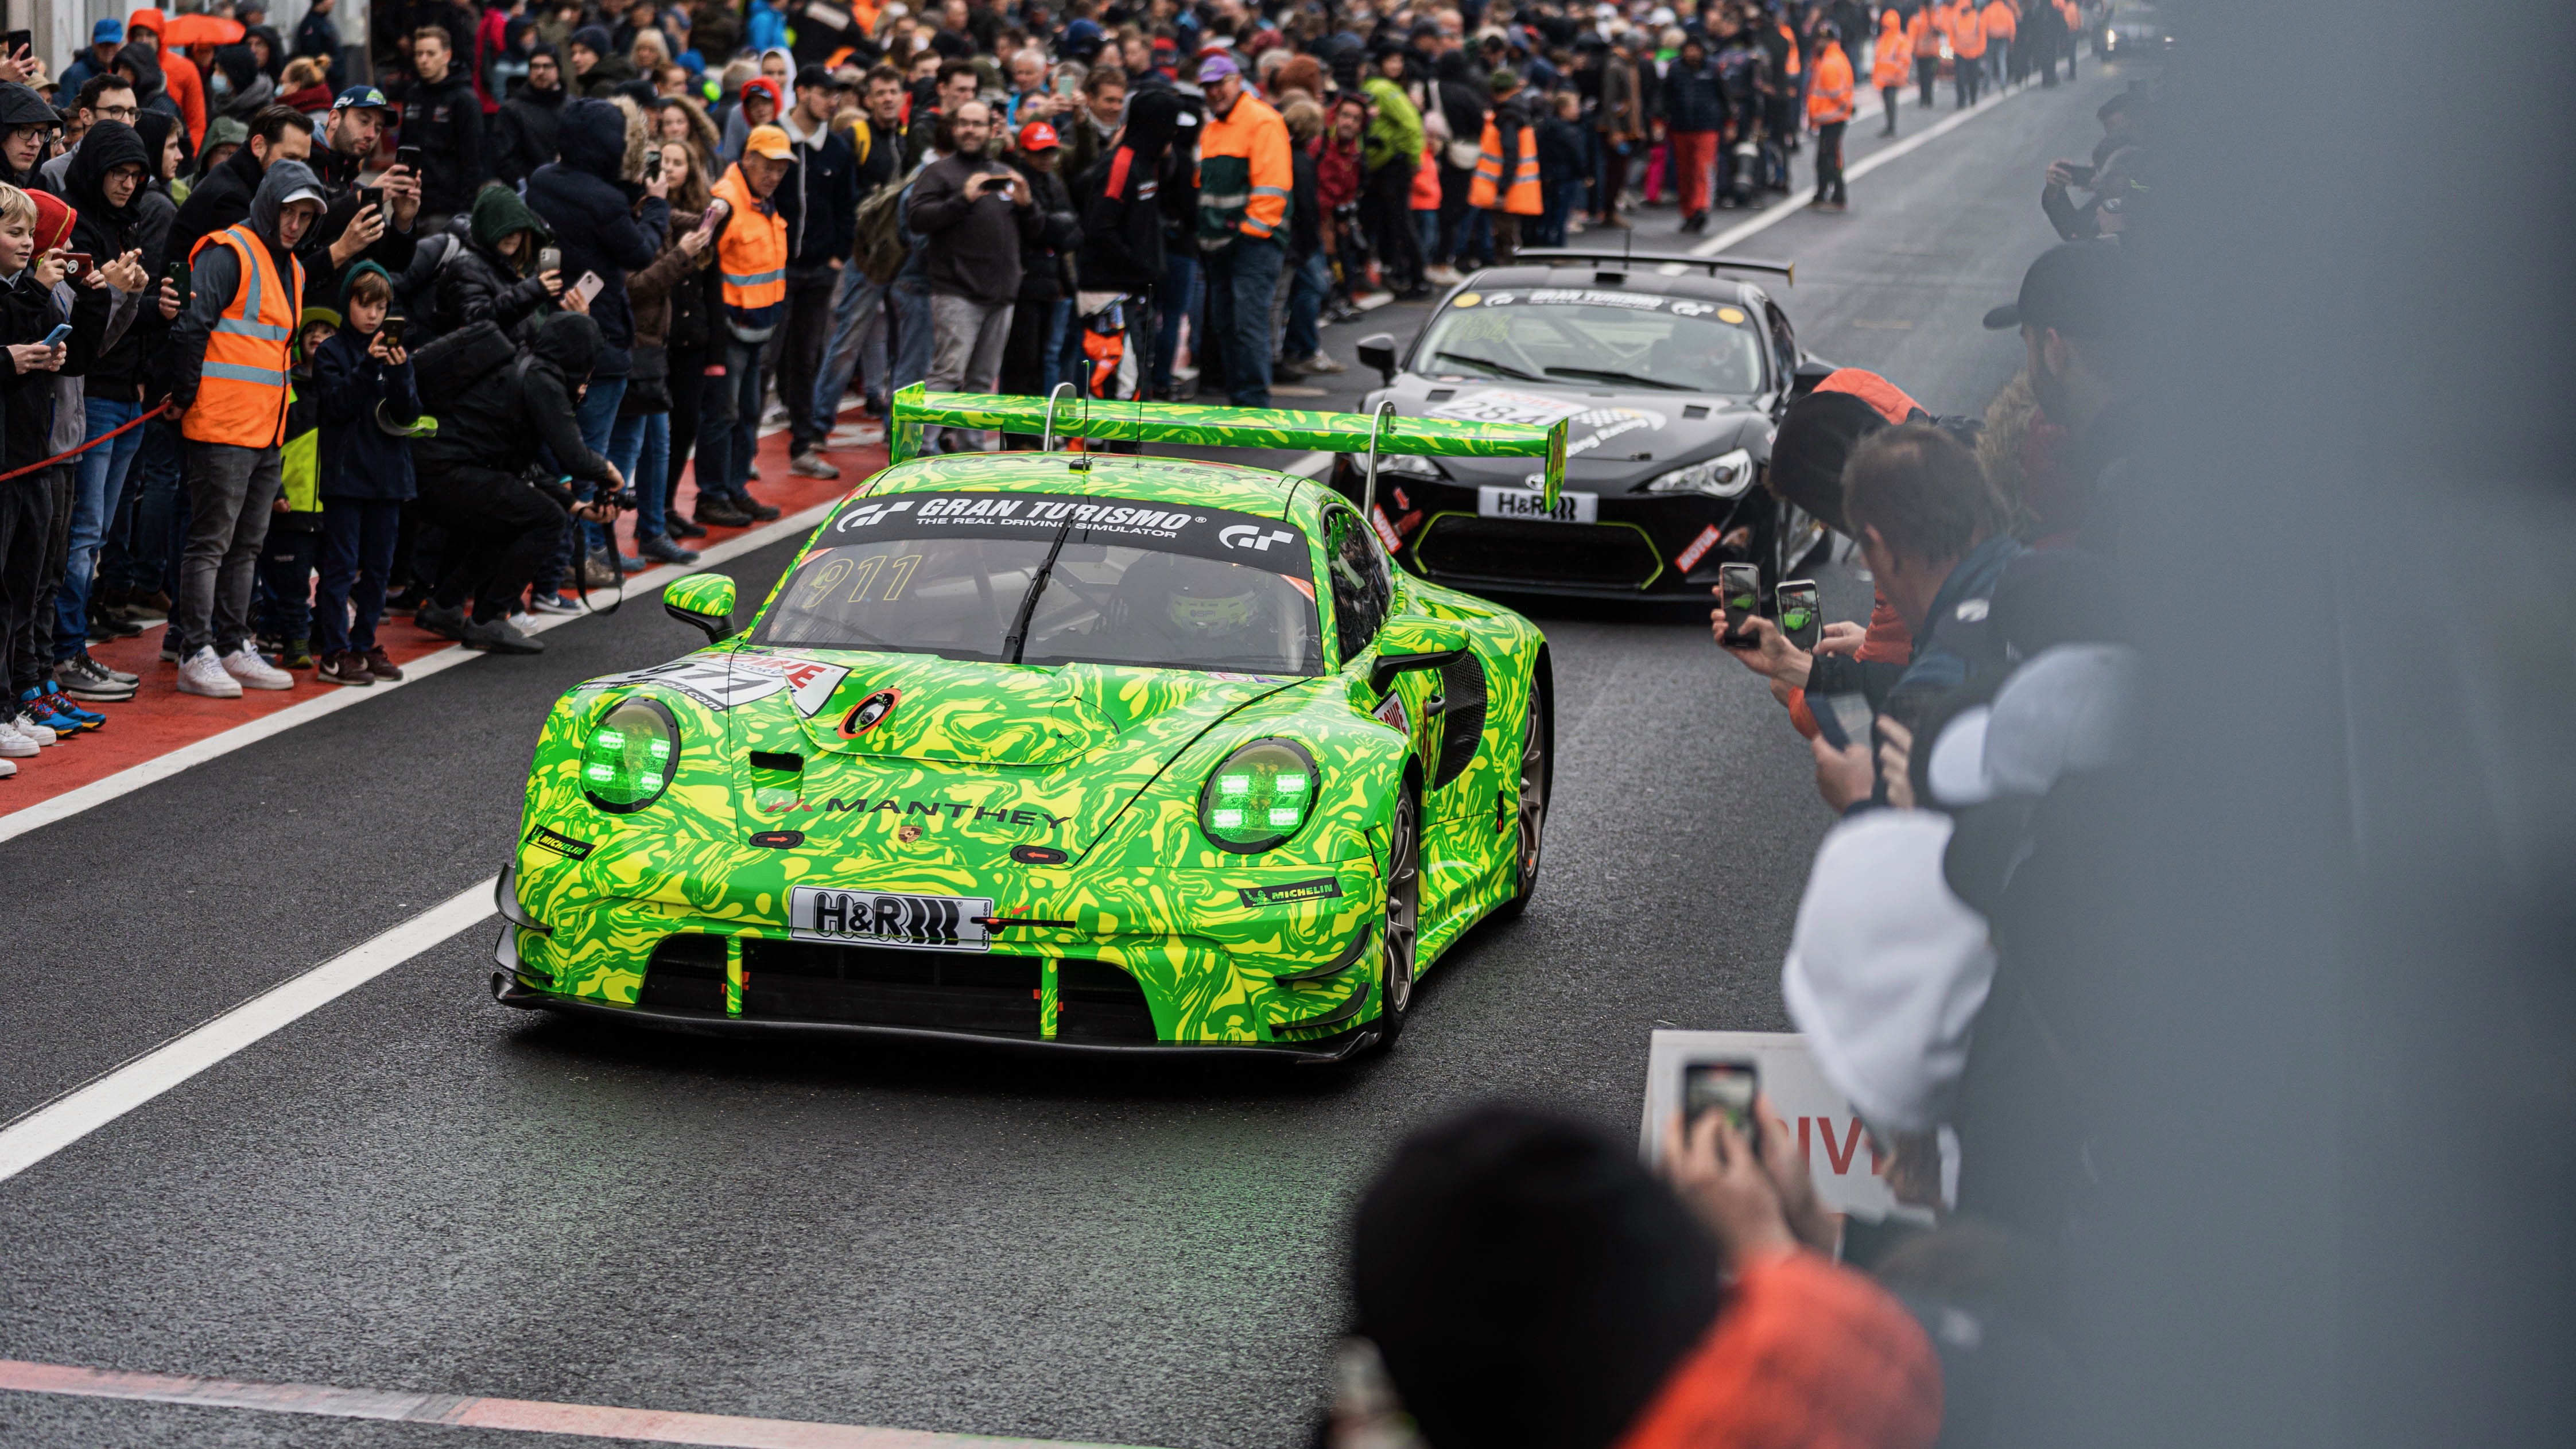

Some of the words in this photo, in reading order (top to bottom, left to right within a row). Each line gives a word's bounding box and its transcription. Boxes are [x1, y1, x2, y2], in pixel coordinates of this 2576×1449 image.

[917, 498, 1024, 517] GRAN
[1026, 501, 1192, 530] TURISMO
[1074, 522, 1177, 539] SIMULATOR
[1679, 528, 1719, 569] MOTUL
[802, 555, 923, 608] 911
[825, 798, 1072, 829] MANTHEY
[540, 836, 586, 855] MICHELIN
[1271, 884, 1333, 899] MICHELIN
[814, 892, 908, 941] H&R
